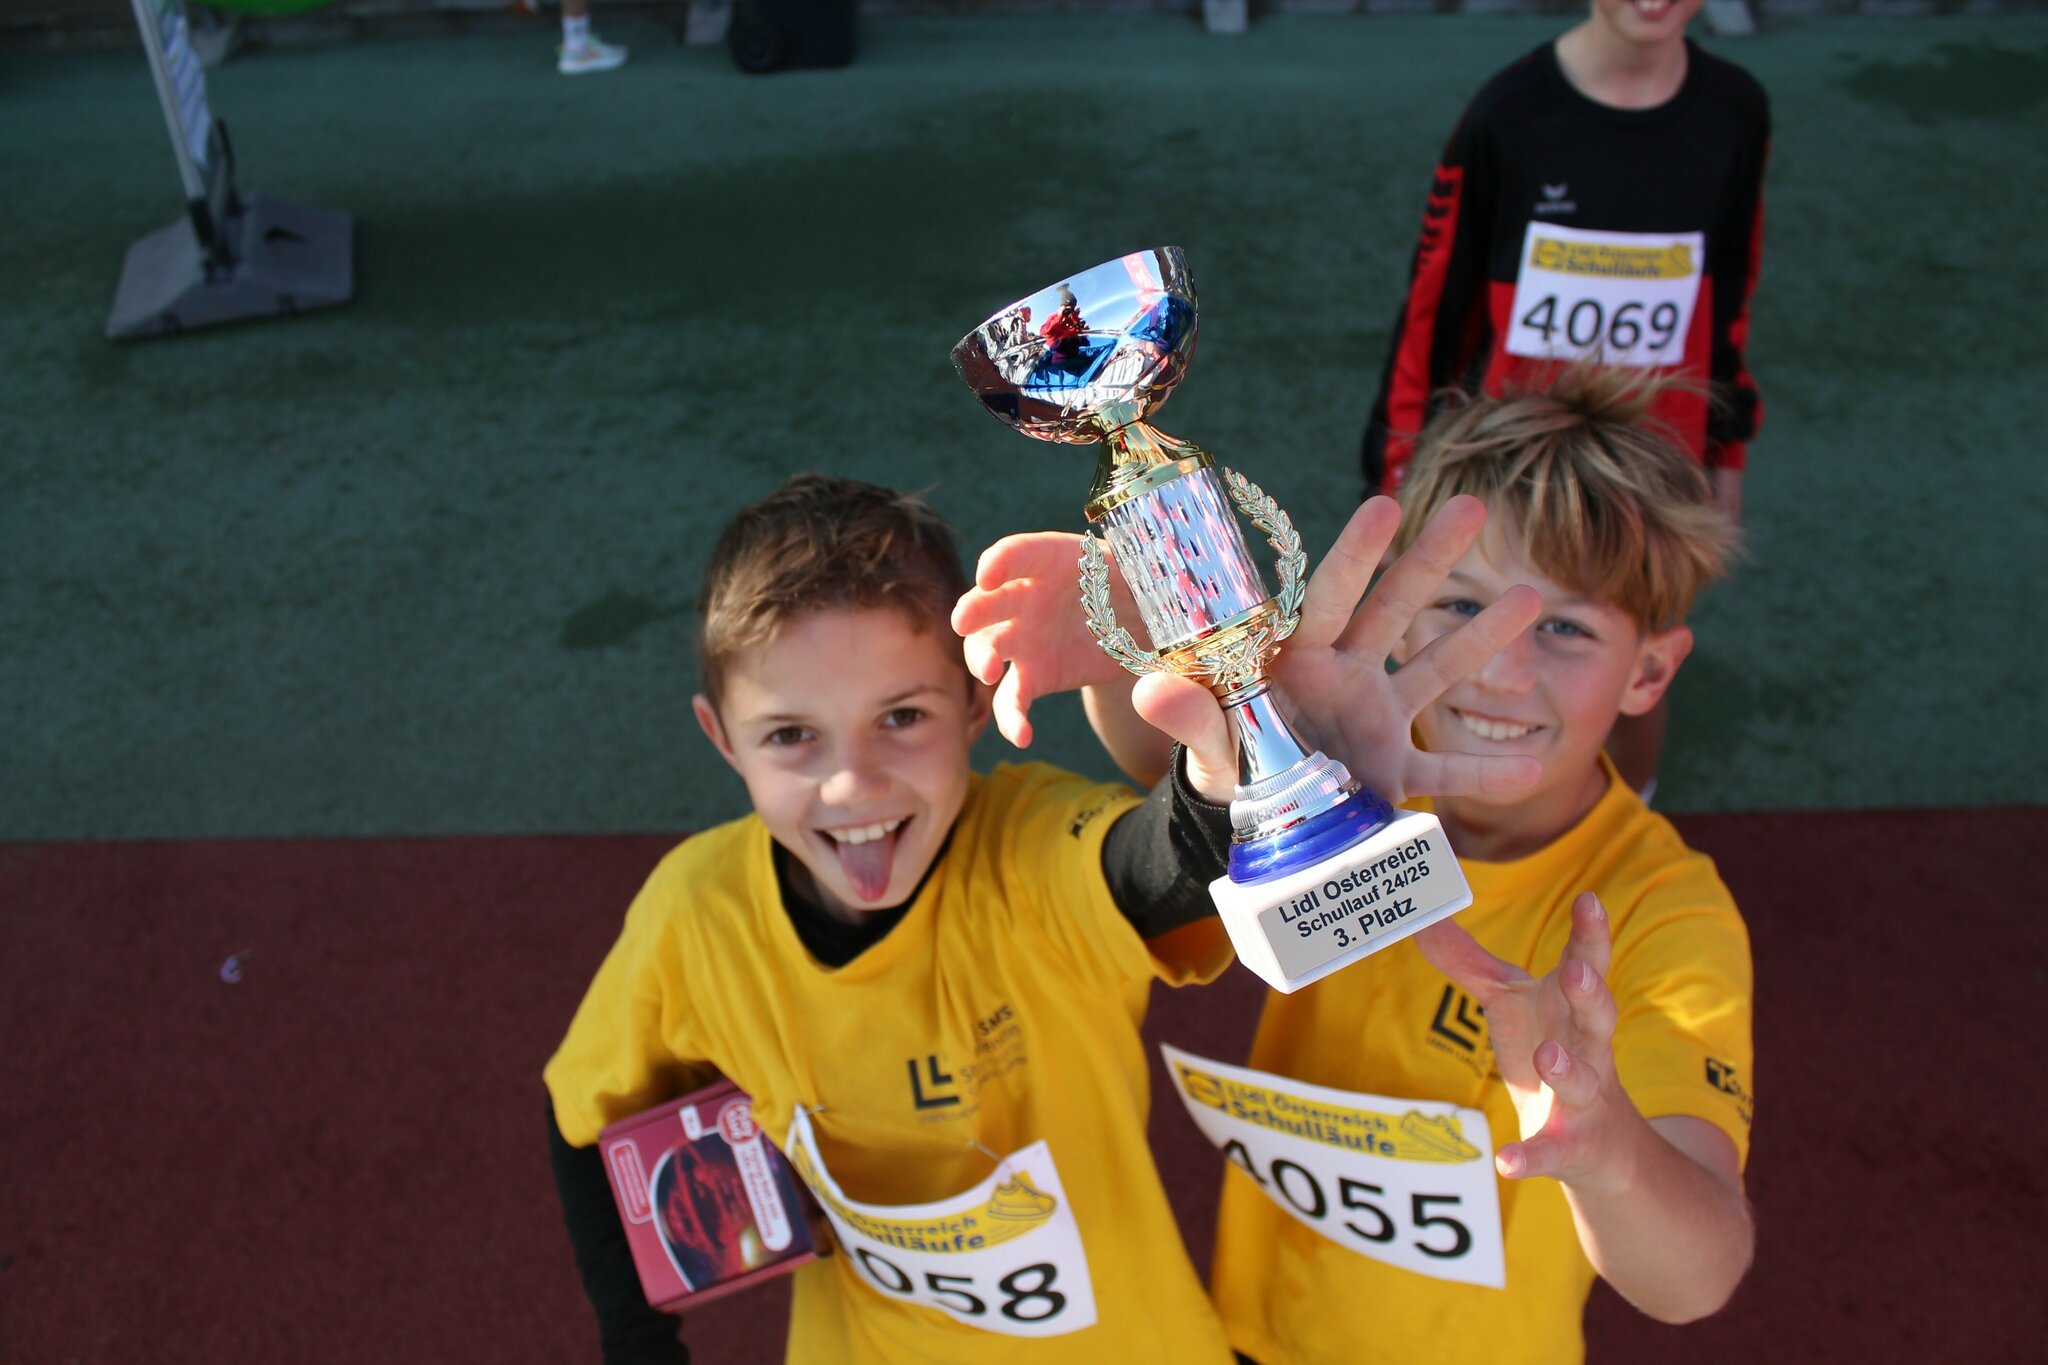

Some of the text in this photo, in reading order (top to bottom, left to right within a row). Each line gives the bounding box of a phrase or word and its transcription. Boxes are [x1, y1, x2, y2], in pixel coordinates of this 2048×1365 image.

[1521, 293, 1679, 350] 4069
[1278, 890, 1321, 924] Lidl
[1297, 860, 1431, 938] Schullauf 24/25
[1333, 896, 1417, 948] 3. Platz
[1232, 1100, 1396, 1157] Schulläufe
[855, 1248, 1067, 1324] 058
